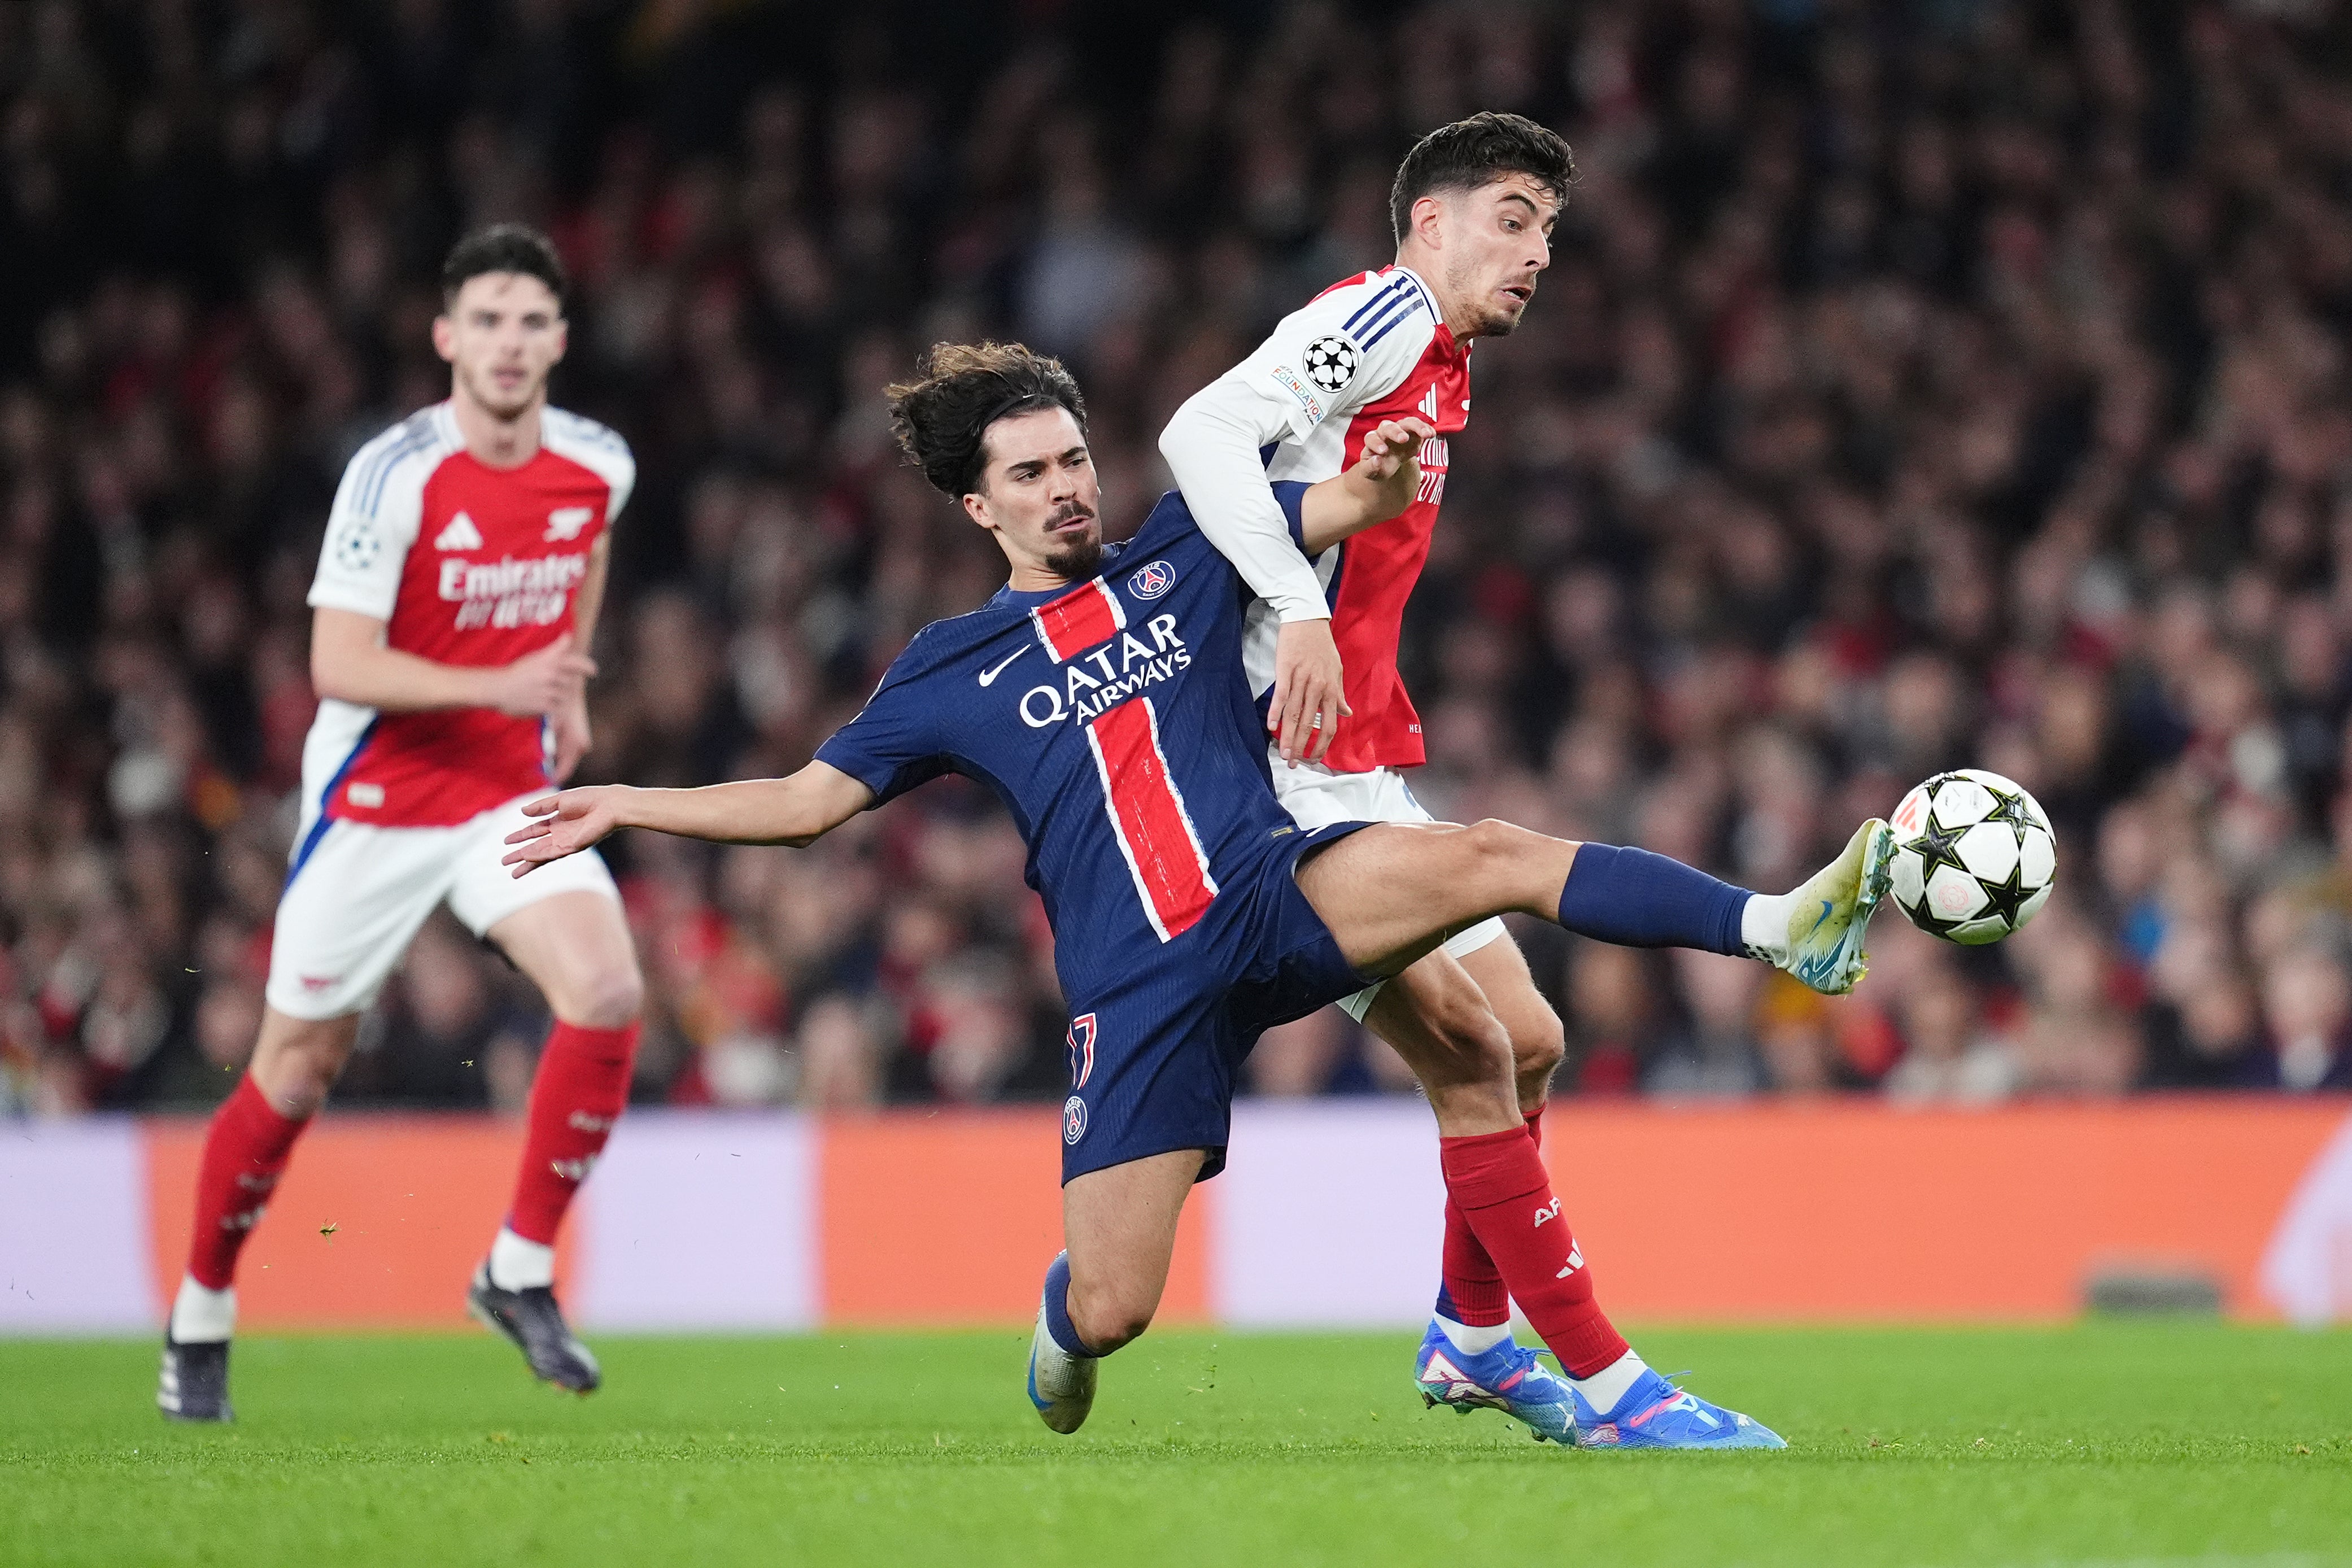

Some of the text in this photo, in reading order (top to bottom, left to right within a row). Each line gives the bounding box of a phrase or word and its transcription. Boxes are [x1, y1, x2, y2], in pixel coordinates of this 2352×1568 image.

[1272, 368, 1323, 422] FOUNDATION
[1019, 614, 1185, 728] QATAR
[1076, 648, 1191, 726] AIRWAYS
[1064, 1099, 1081, 1114] PARIS
